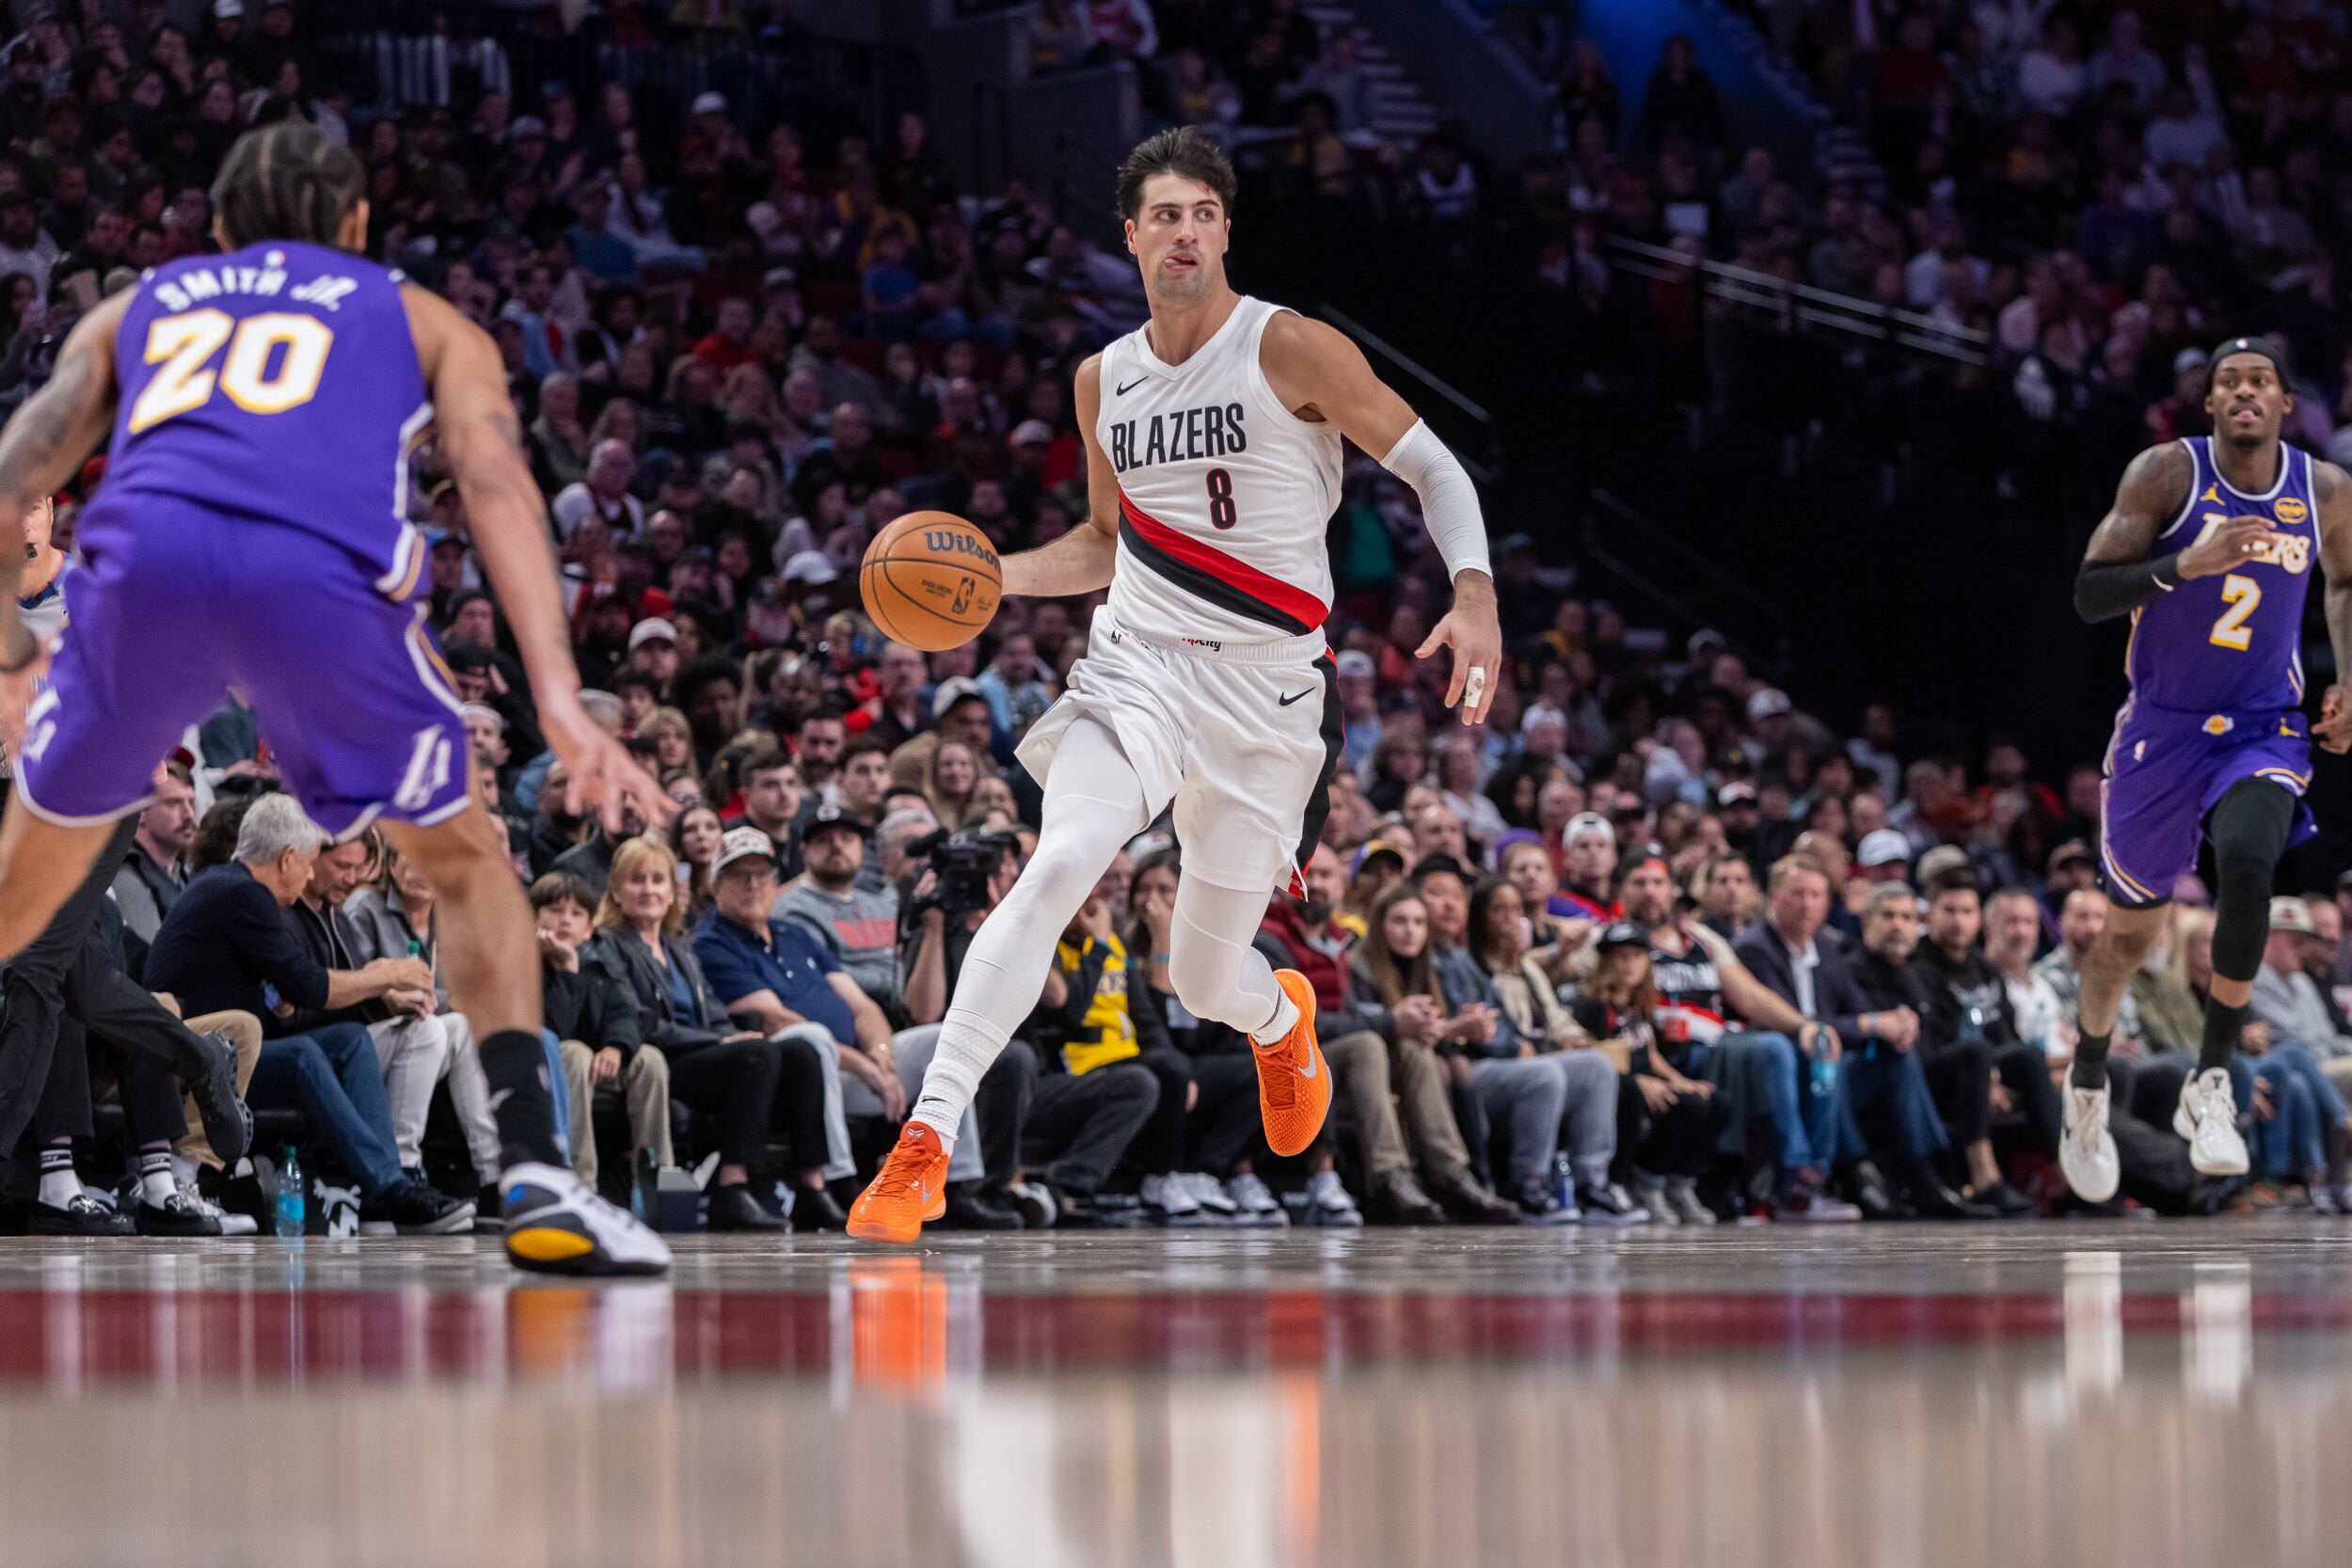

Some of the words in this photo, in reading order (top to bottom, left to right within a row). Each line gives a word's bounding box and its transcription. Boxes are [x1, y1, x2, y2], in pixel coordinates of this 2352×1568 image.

[153, 265, 288, 312] SMITH
[127, 307, 335, 436] 20
[1110, 403, 1248, 473] BLAZERS
[1206, 467, 1237, 530] 8
[2209, 573, 2262, 651] 2
